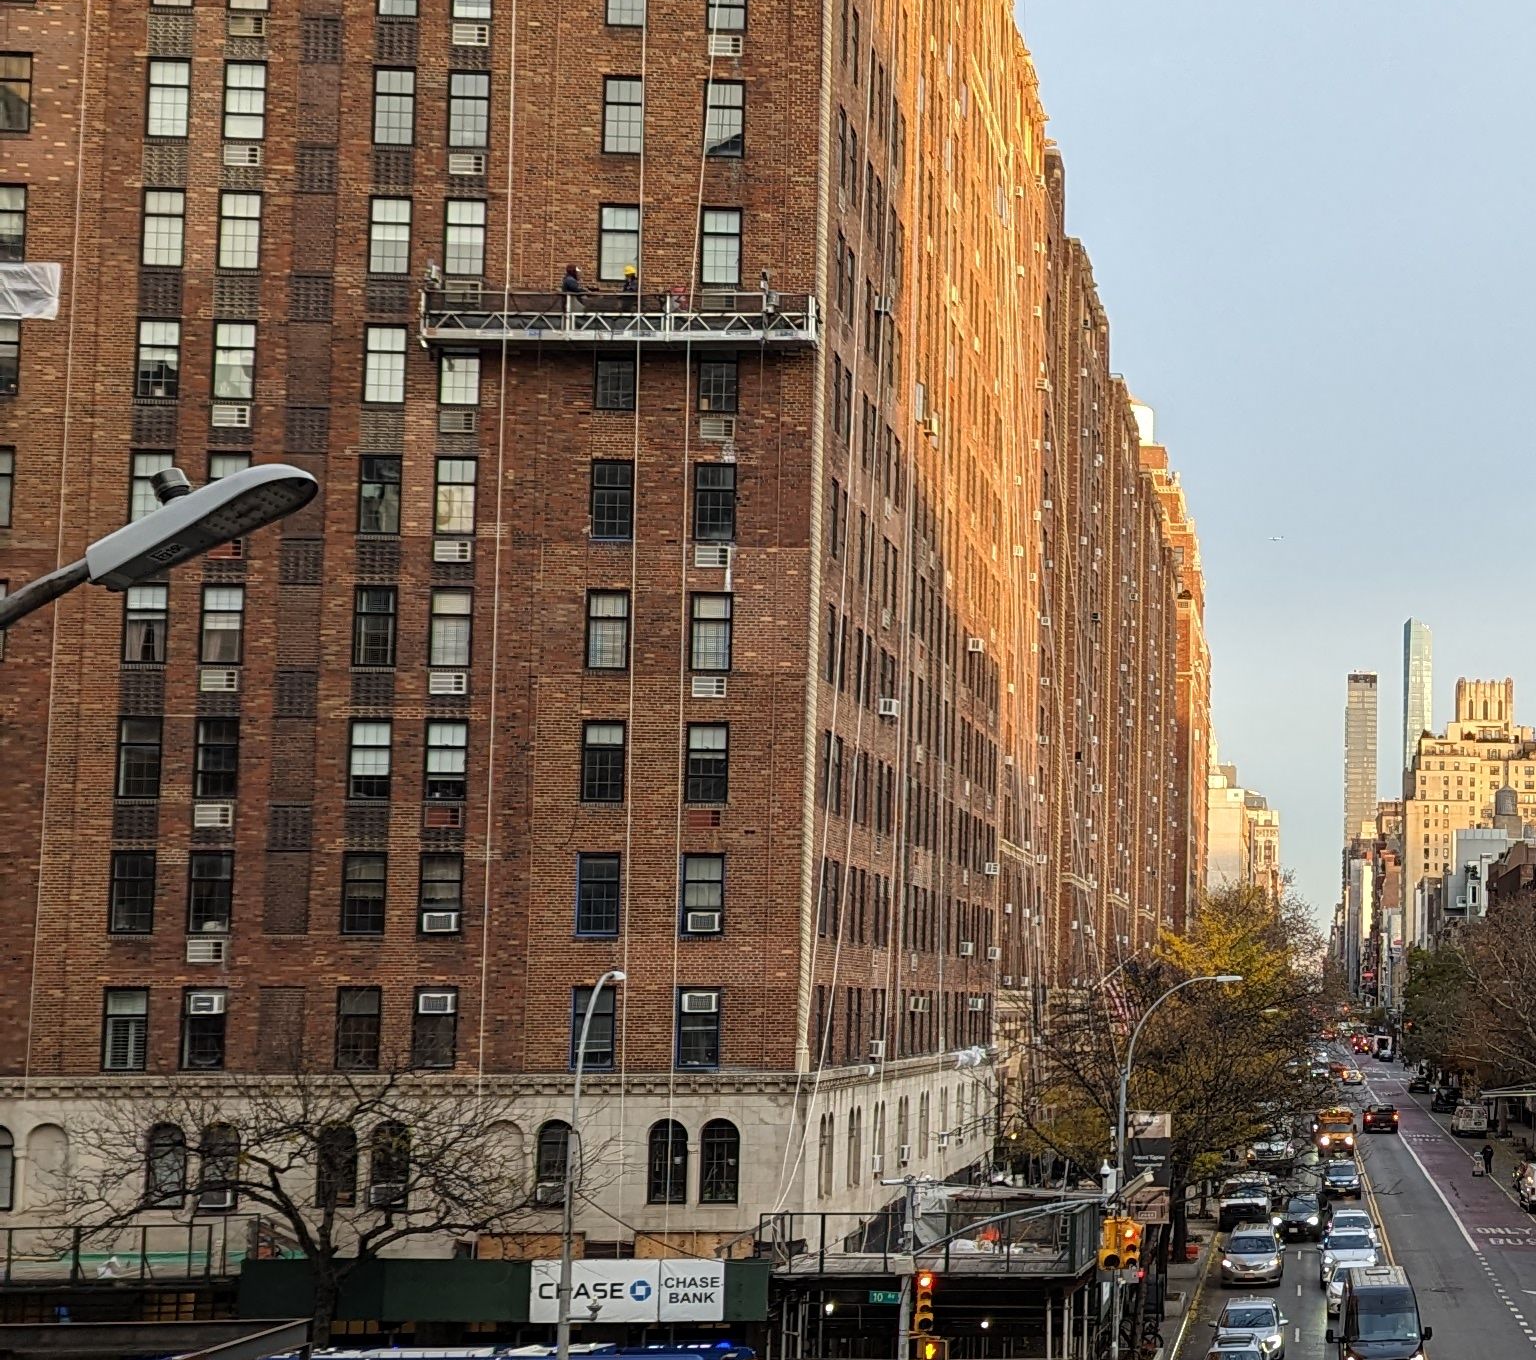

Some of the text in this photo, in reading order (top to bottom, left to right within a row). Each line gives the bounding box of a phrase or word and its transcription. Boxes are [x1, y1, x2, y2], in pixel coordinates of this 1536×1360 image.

[1476, 1227, 1532, 1235] ONLY
[664, 1276, 720, 1289] CHASE
[668, 1292, 715, 1304] BANK
[873, 1292, 884, 1302] 10
